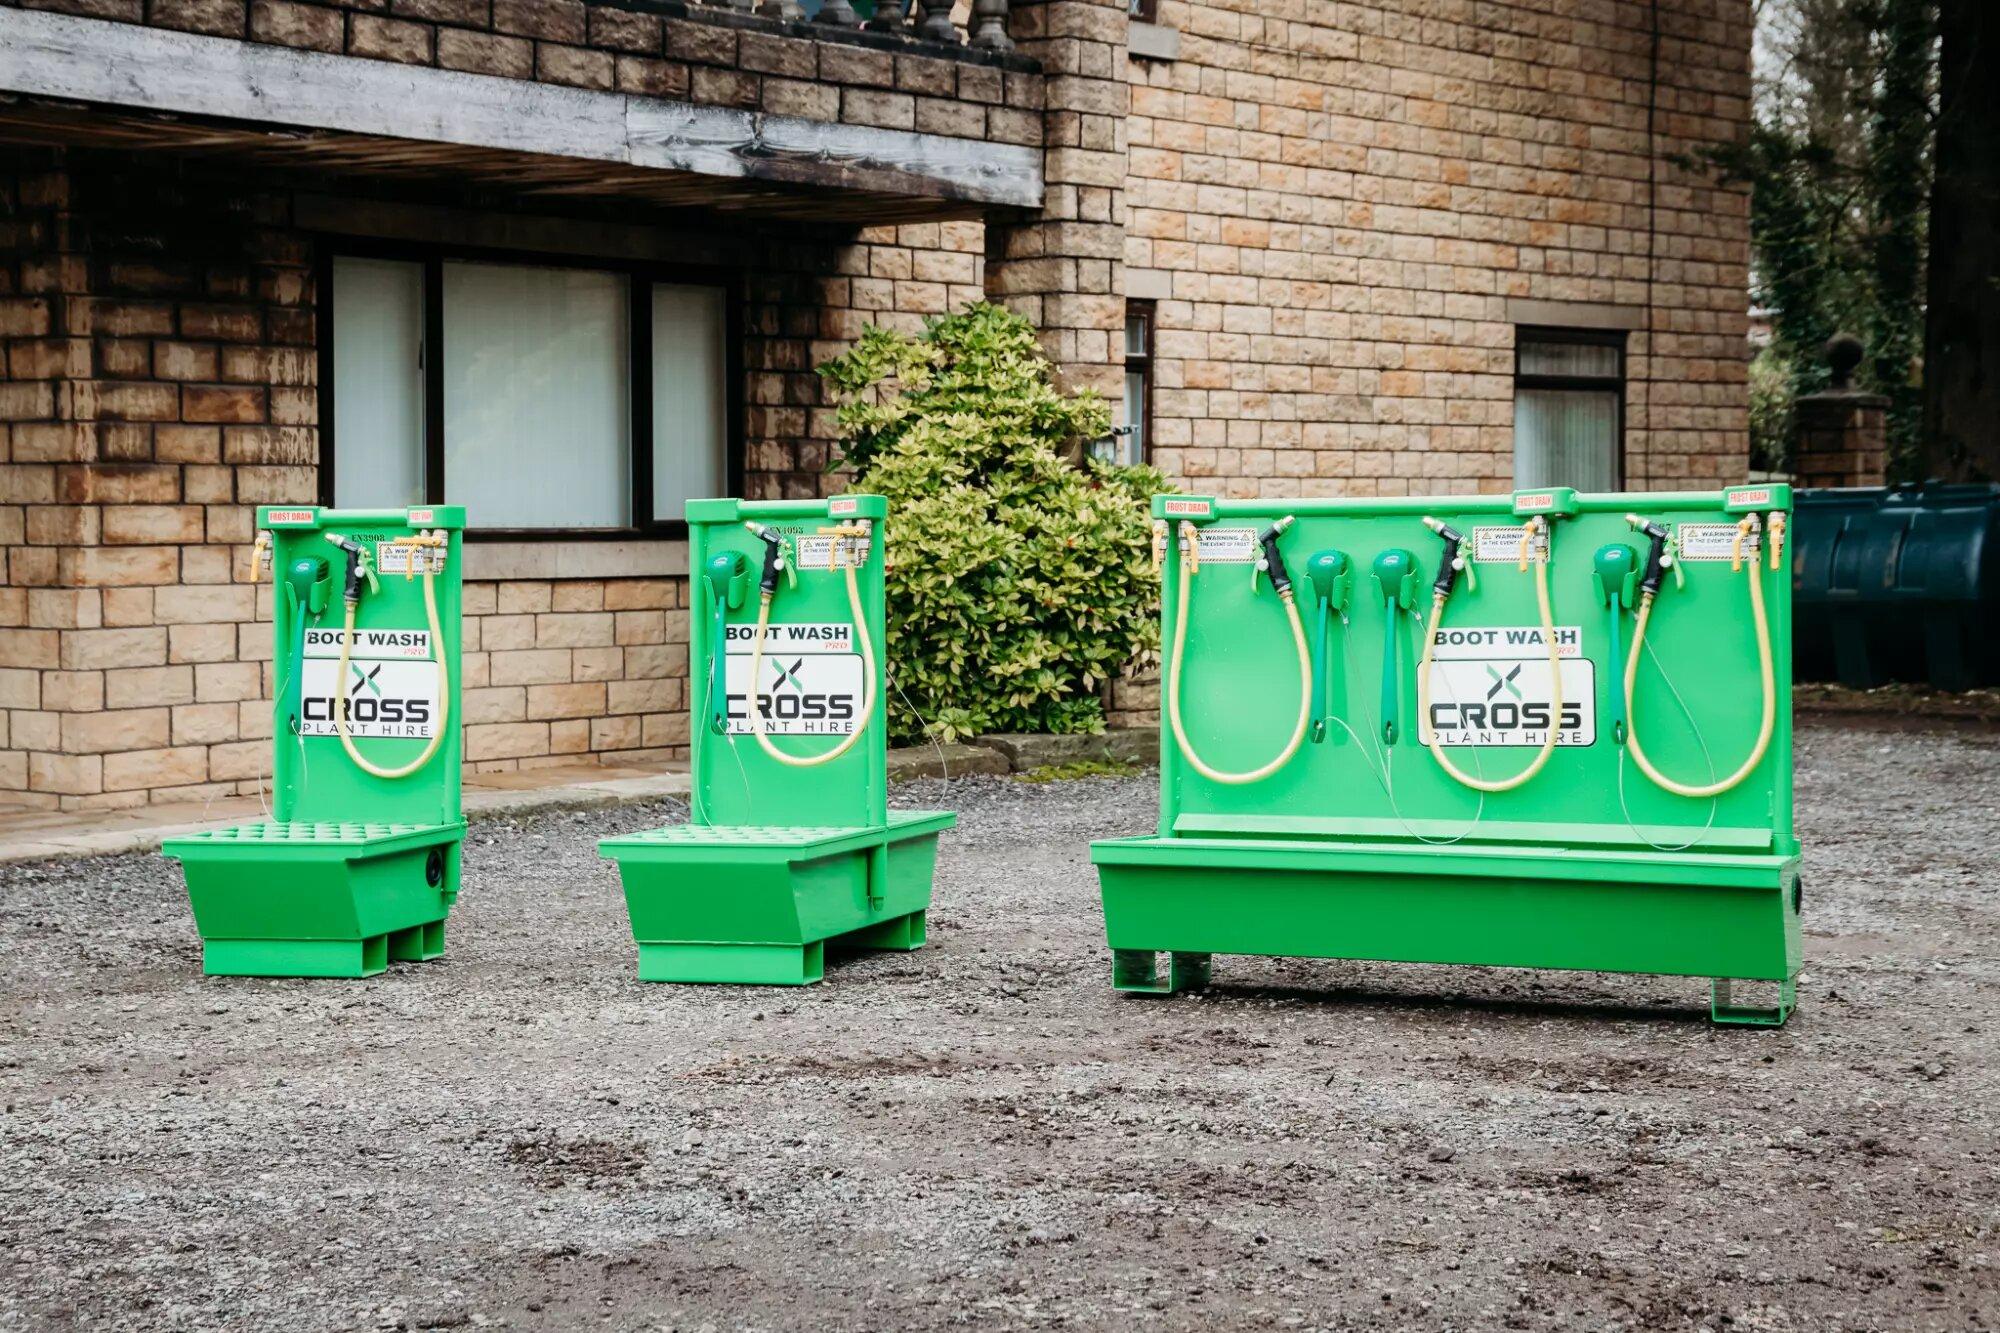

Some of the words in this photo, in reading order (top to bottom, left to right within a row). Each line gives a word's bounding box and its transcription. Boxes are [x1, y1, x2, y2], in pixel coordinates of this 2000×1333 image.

[1167, 502, 1187, 512] FROST
[1188, 503, 1208, 512] DRAIN
[270, 512, 290, 521] FROST
[291, 512, 312, 521] DRAIN
[368, 633, 426, 646] WASH
[788, 627, 848, 640] WASH
[1434, 631, 1498, 645] BOOT
[825, 642, 847, 650] PRO
[303, 697, 430, 723] CROSS
[726, 694, 853, 719] CROSS
[1430, 703, 1581, 729] CROSS
[303, 723, 368, 734] PLANT
[382, 725, 429, 736] HIRE
[805, 722, 853, 732] HIRE
[1525, 732, 1582, 743] HIRE
